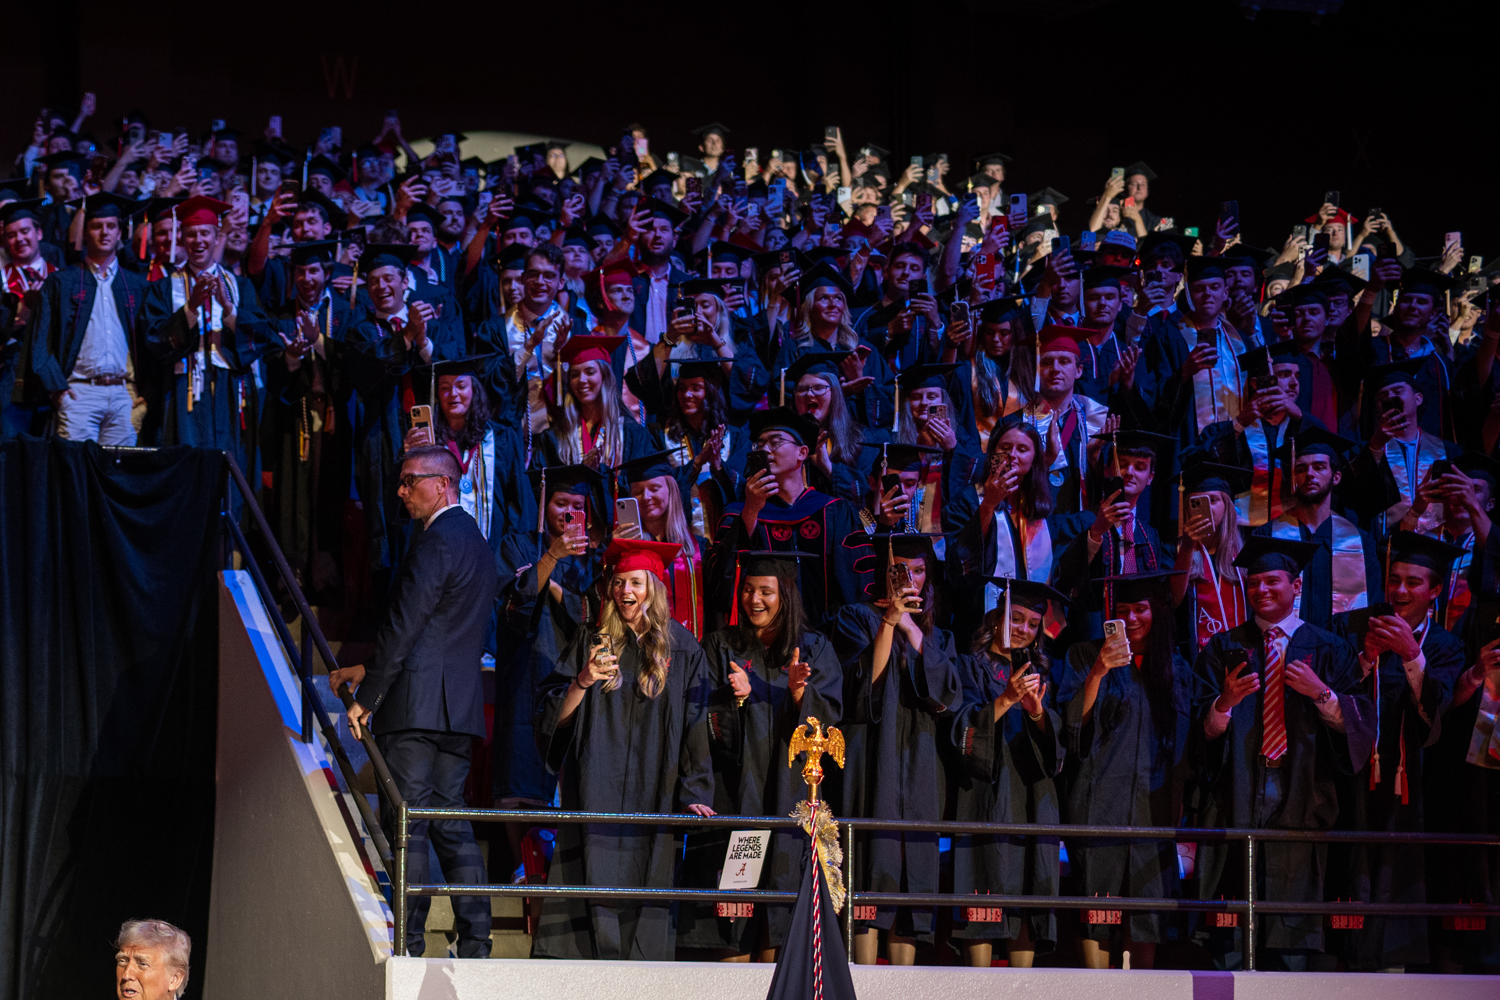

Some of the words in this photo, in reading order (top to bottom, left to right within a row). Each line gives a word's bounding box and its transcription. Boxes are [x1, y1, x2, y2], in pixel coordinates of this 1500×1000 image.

[738, 836, 762, 844] WHERE
[732, 844, 762, 852] LEGENDS
[728, 852, 742, 860] ARE
[742, 851, 762, 859] MADE
